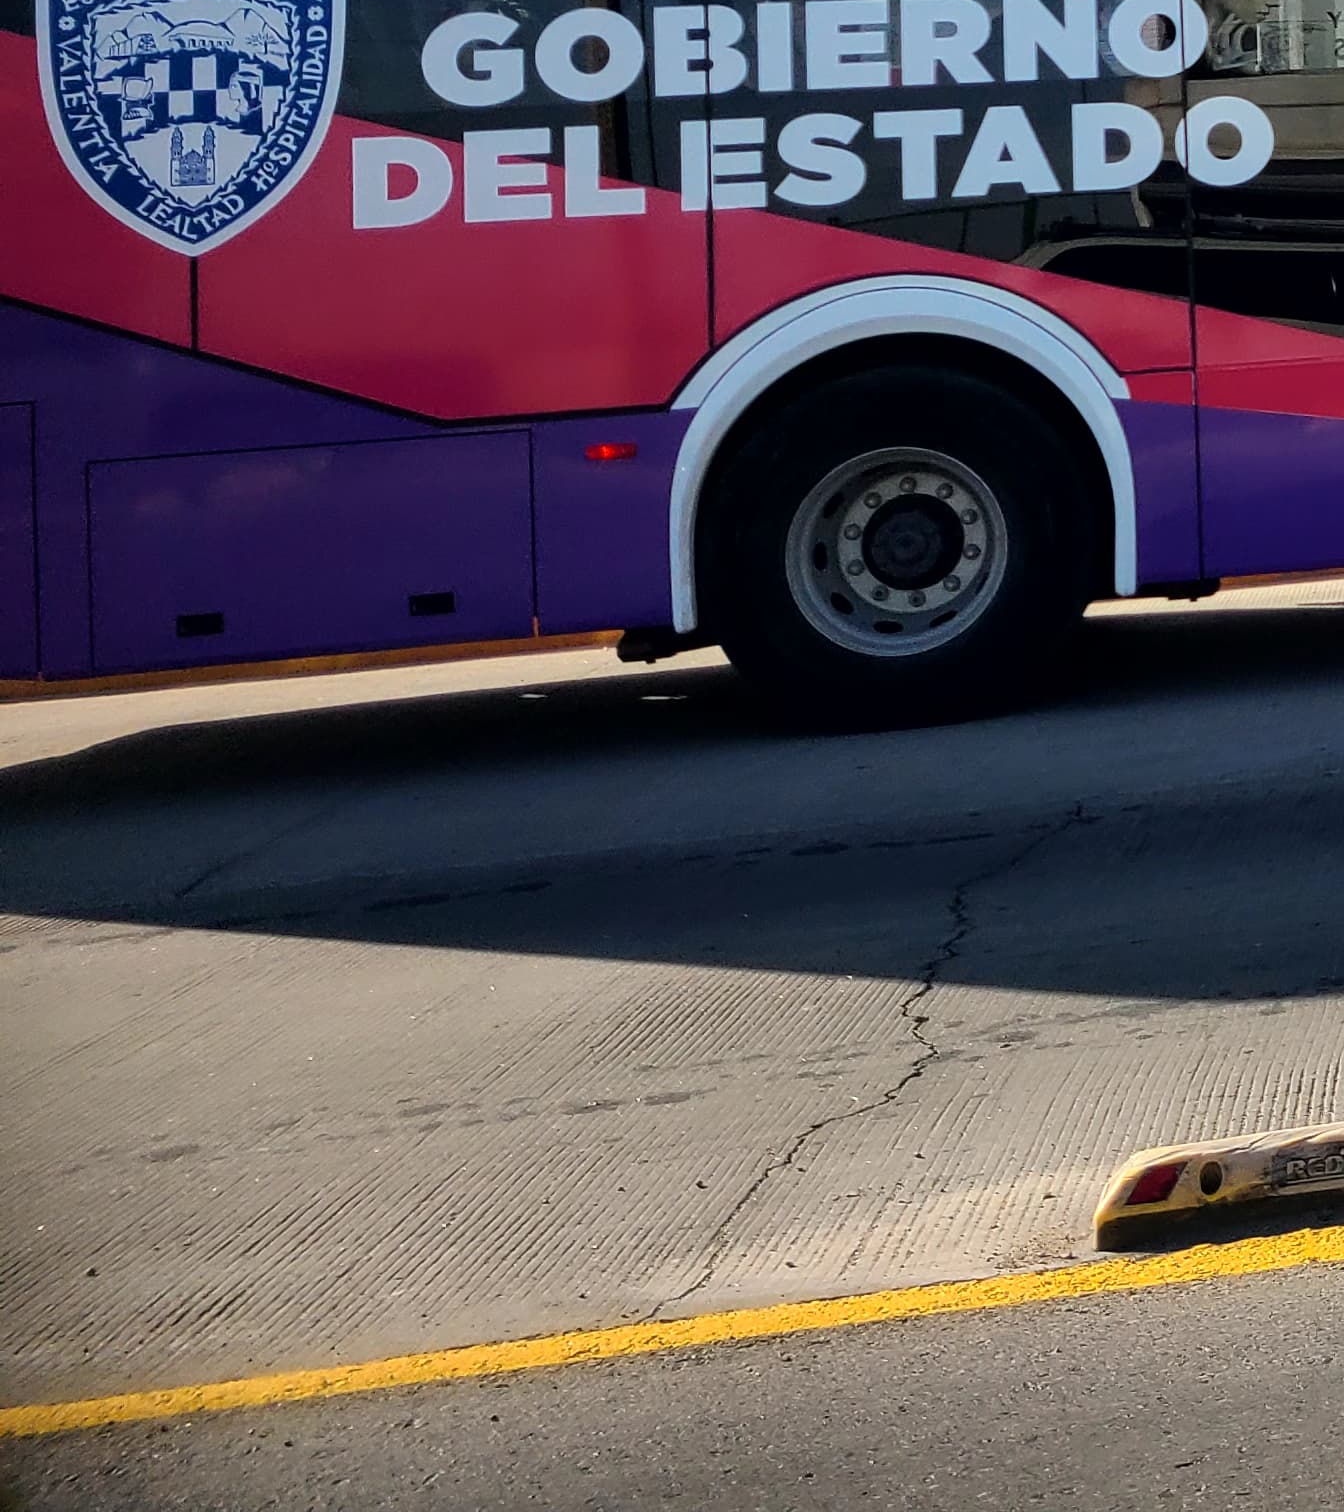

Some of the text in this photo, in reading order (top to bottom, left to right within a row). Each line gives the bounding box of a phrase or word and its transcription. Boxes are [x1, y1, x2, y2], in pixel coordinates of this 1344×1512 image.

[56, 38, 120, 183] VALENTIA
[351, 96, 1275, 230] DEL ESTADO
[136, 194, 245, 240] LEALTAD
